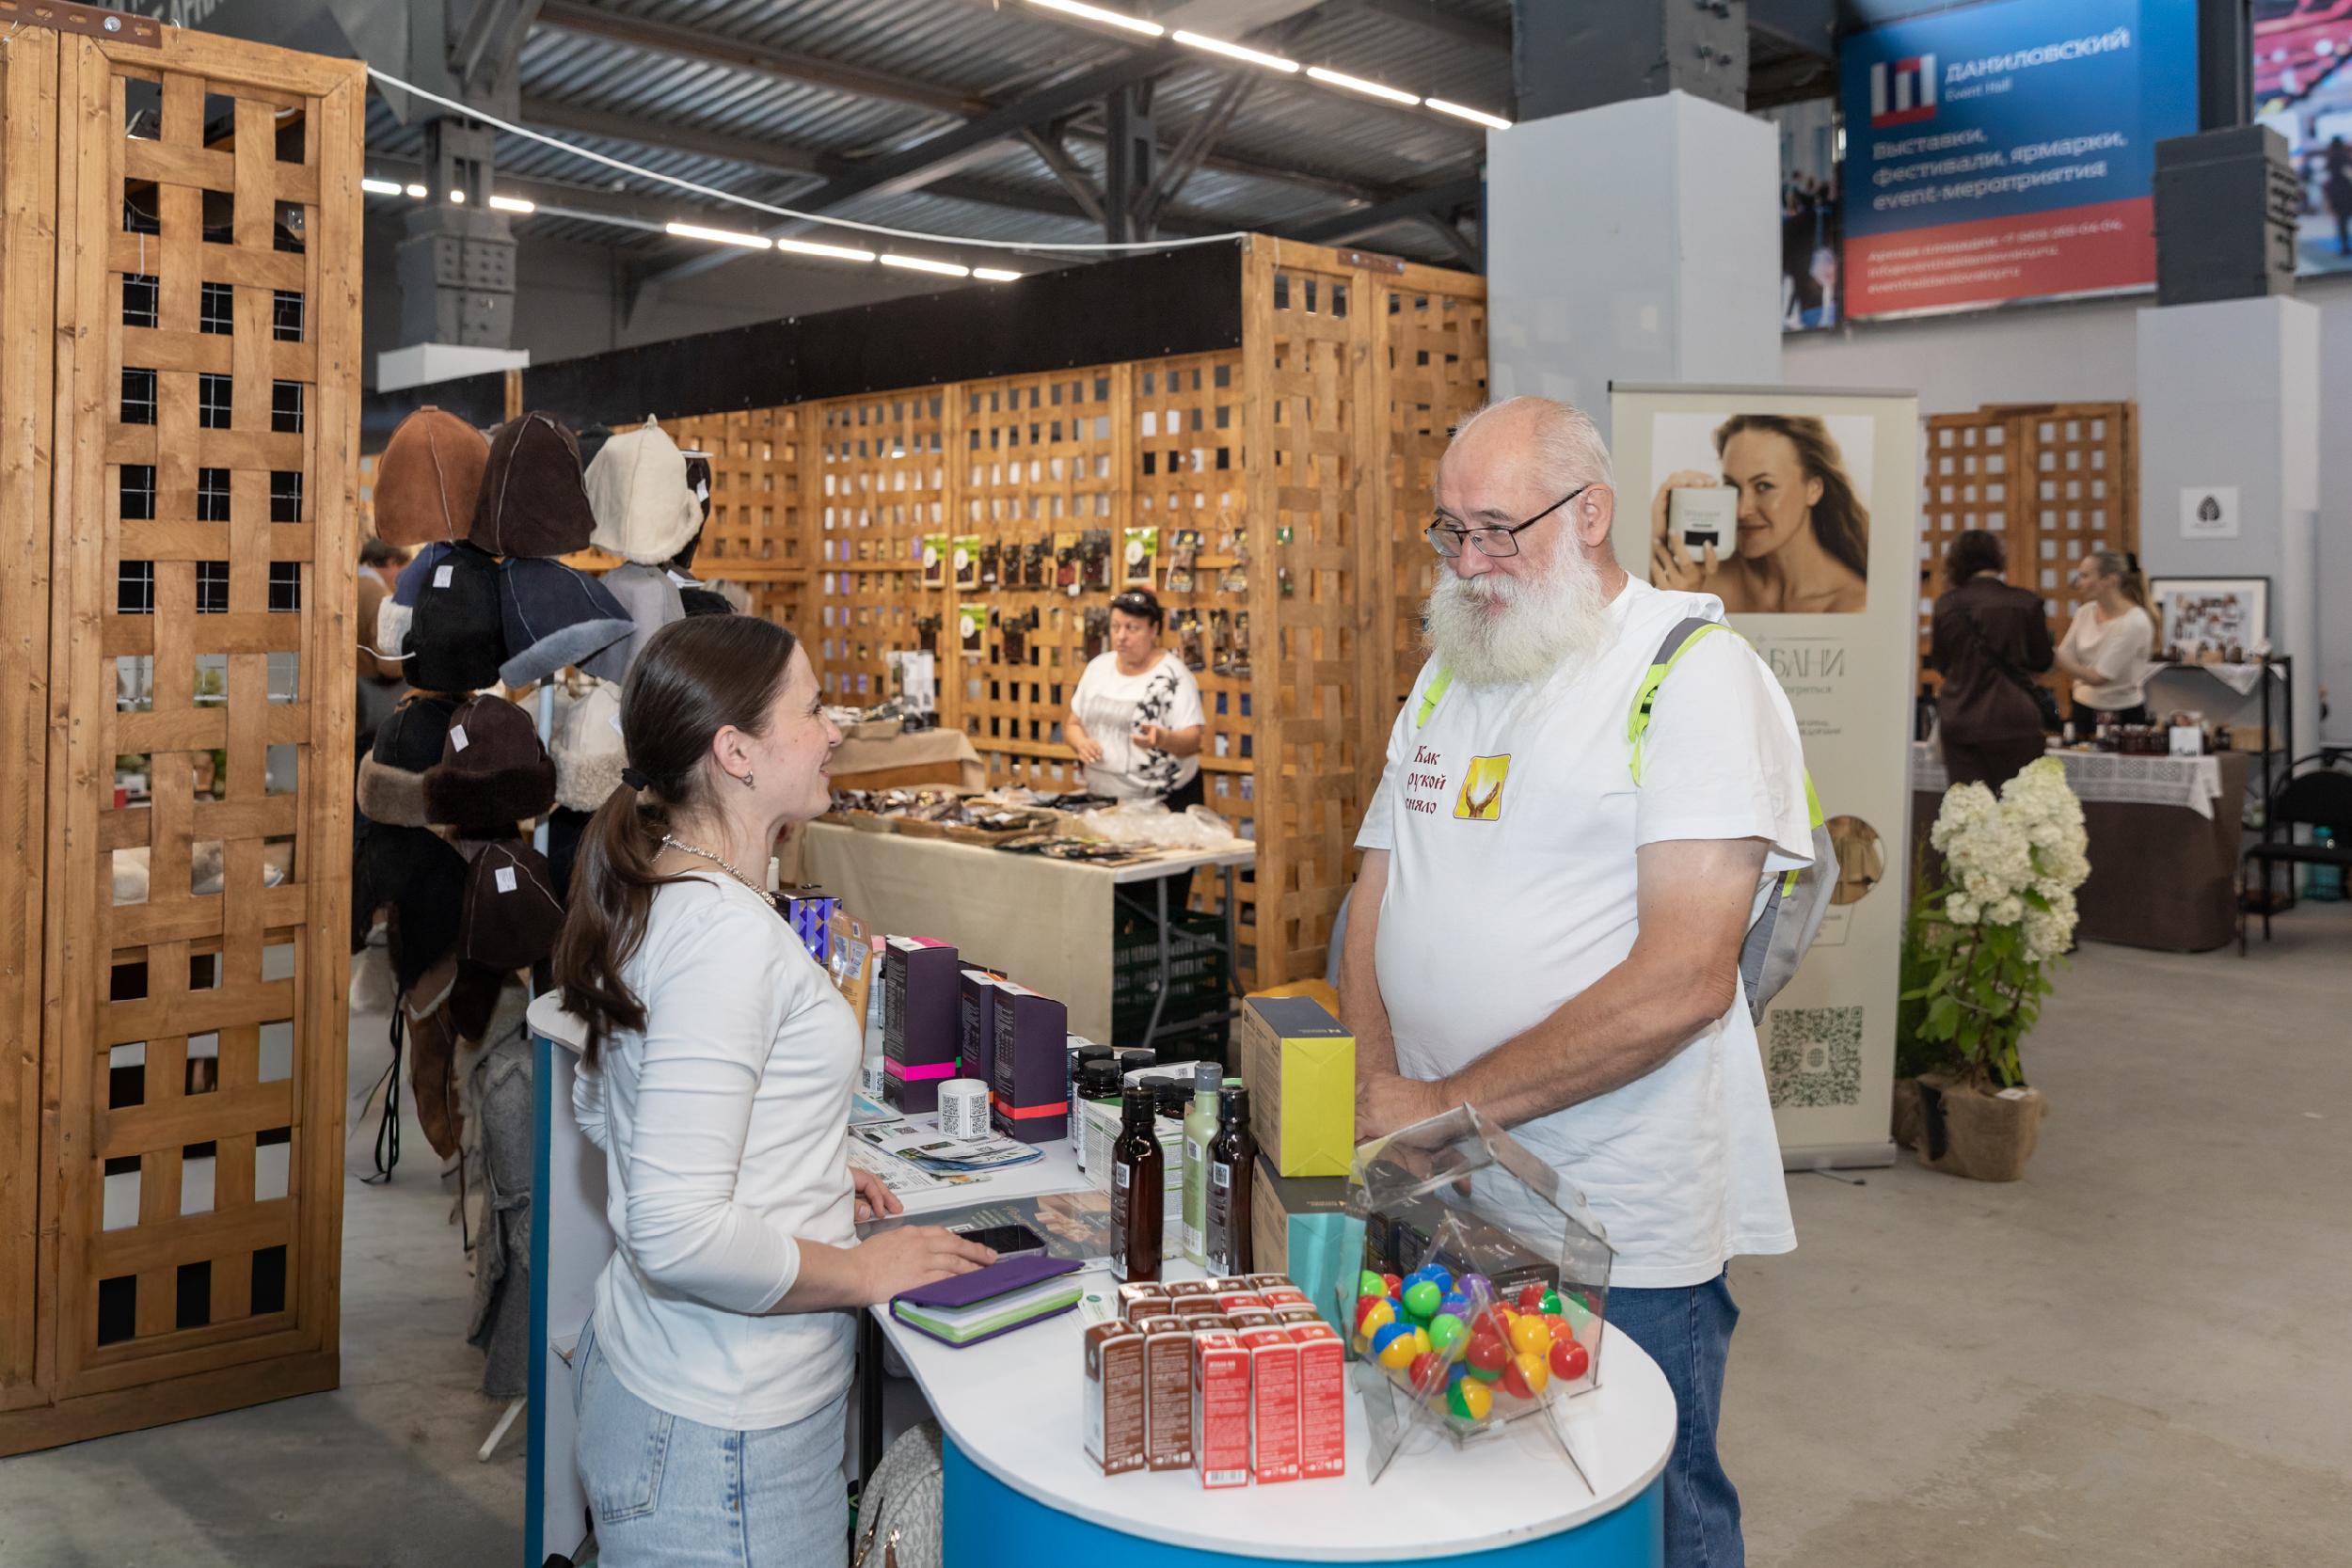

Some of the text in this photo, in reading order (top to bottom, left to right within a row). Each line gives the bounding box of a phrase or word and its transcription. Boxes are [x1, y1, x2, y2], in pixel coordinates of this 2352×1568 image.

[1946, 26, 2129, 83] ДАНИЛОВСКИЙ
[1945, 76, 2013, 103] Event Hall
[1872, 128, 1988, 161] Выставки,
[1872, 131, 2128, 187] фестивали, ярмарки,
[1872, 160, 2107, 212] event-мероприятия
[1414, 745, 1440, 765] Как
[1407, 772, 1446, 792] рукой
